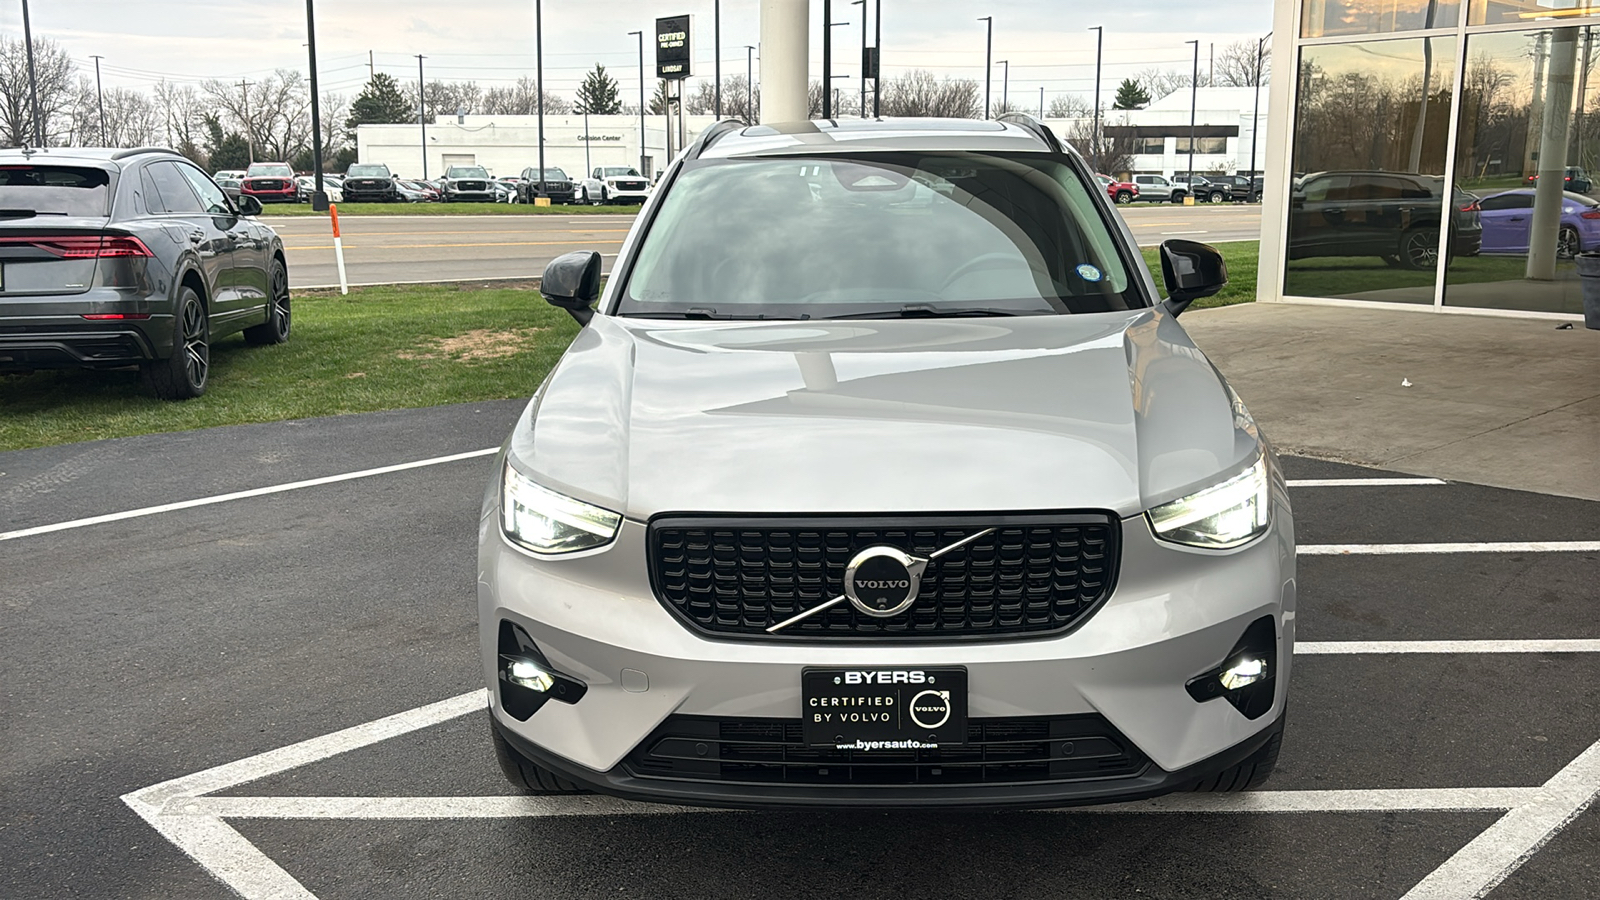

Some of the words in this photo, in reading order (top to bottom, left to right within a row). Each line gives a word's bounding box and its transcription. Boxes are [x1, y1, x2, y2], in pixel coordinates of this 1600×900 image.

[658, 31, 686, 42] CERTIFIED
[660, 40, 684, 48] PRE-OWNED
[662, 65, 682, 73] LINDSAY
[855, 580, 909, 589] VOLVO
[845, 671, 926, 684] BYERS
[809, 697, 894, 706] CERTIFIED
[814, 713, 832, 723] BY
[840, 713, 890, 722] VOLVO
[836, 739, 938, 751] www.byersauto.com
